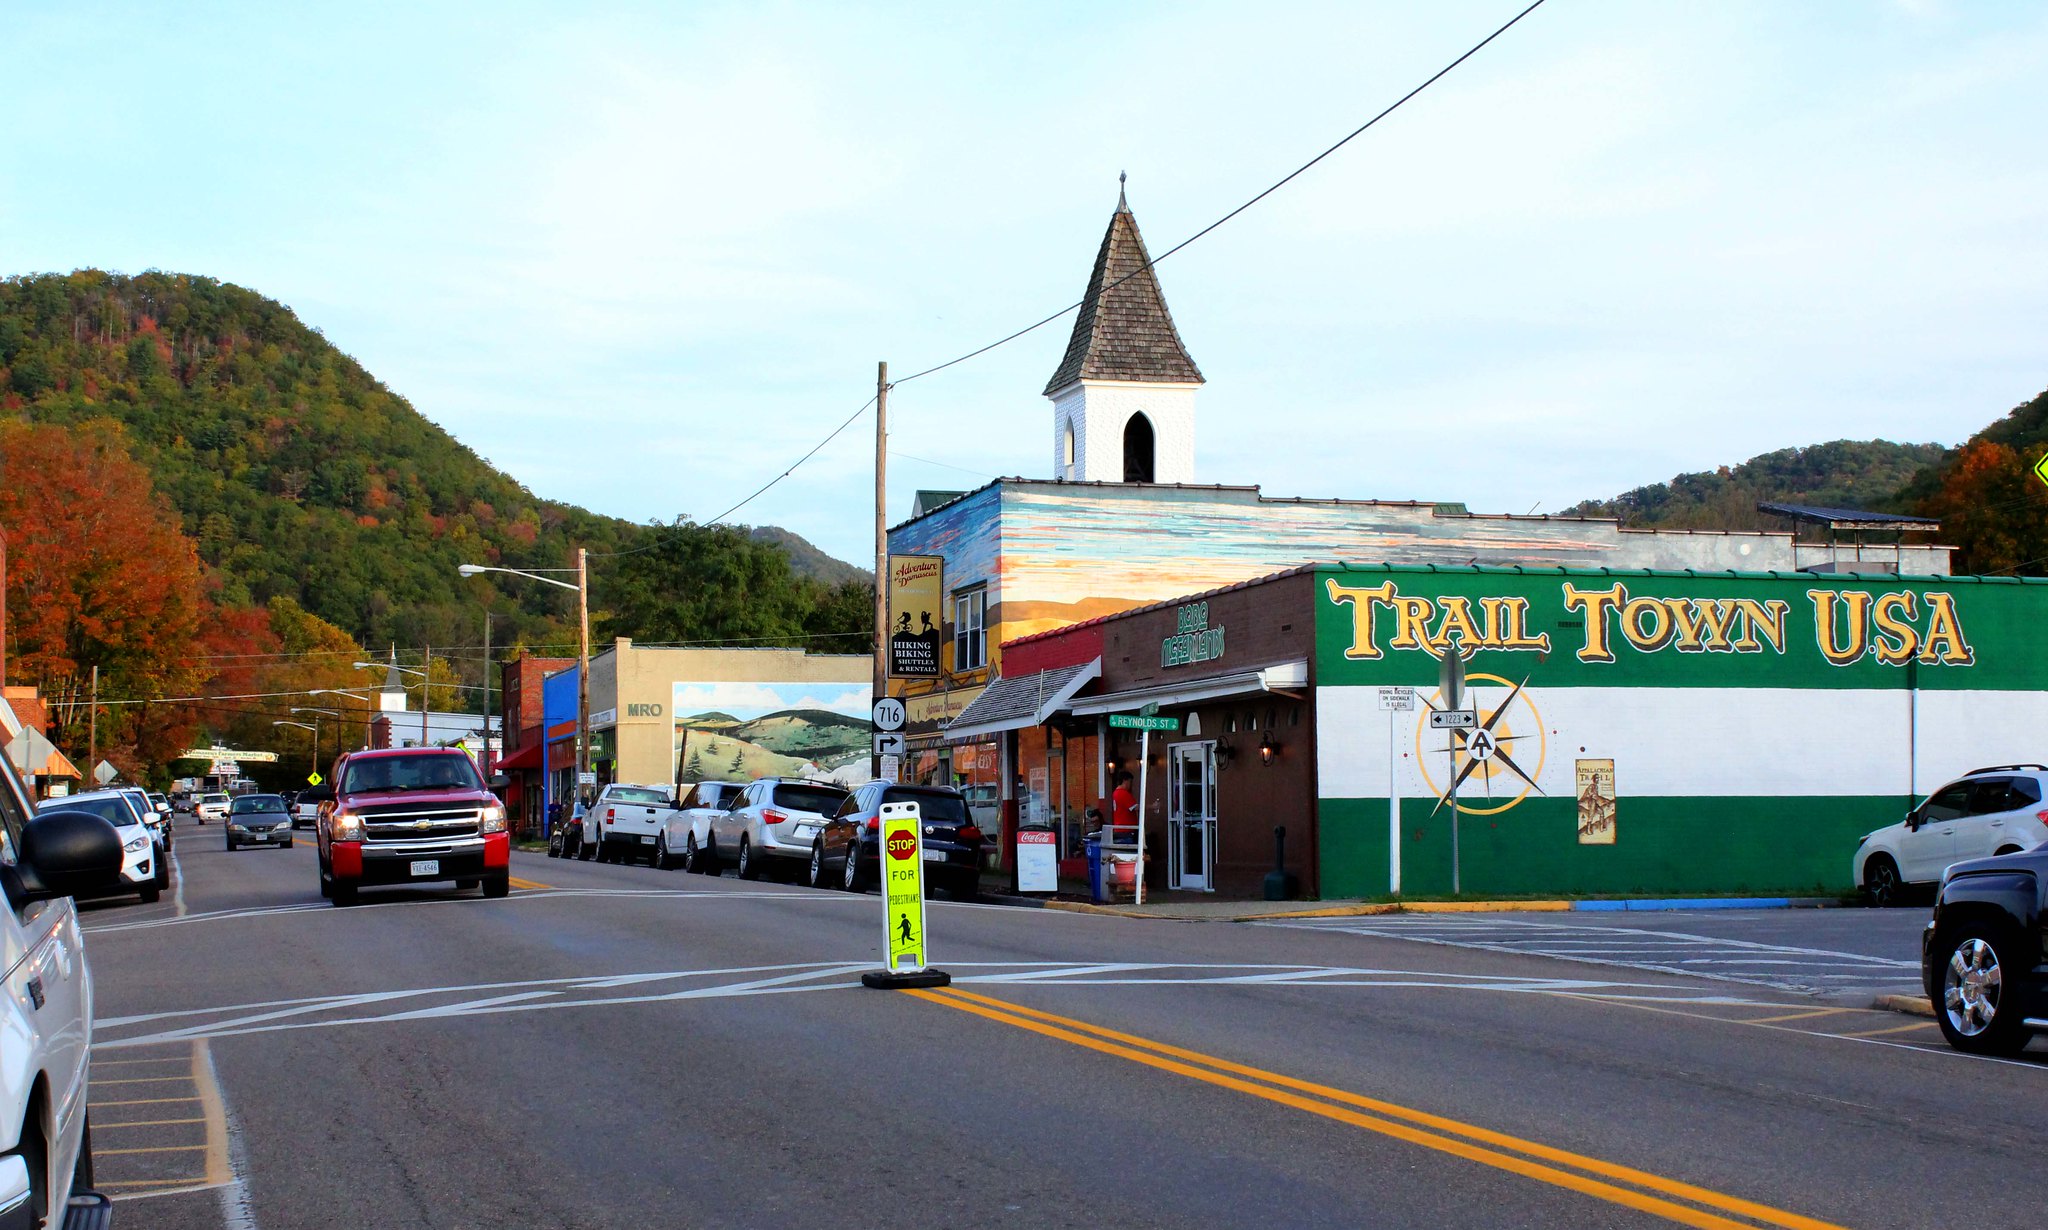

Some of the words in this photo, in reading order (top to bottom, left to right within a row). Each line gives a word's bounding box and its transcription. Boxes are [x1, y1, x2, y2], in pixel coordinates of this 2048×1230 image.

[896, 562, 938, 577] Adventure
[895, 571, 938, 588] Damascus
[1178, 601, 1209, 635] BOBO
[1326, 578, 1551, 662] TRAIL
[1563, 581, 1790, 664] TOWN
[893, 641, 932, 650] HIKING
[895, 650, 932, 658] BIKING
[627, 703, 663, 716] MRO
[879, 706, 900, 722] 716
[1117, 717, 1157, 728] REYNOLDS
[1160, 719, 1169, 729] ST
[1445, 714, 1461, 724] 1223
[1580, 773, 1610, 781] TRIL
[888, 839, 915, 851] STOP
[892, 870, 915, 881] FOR
[889, 893, 919, 906] PEDESTRIANS
